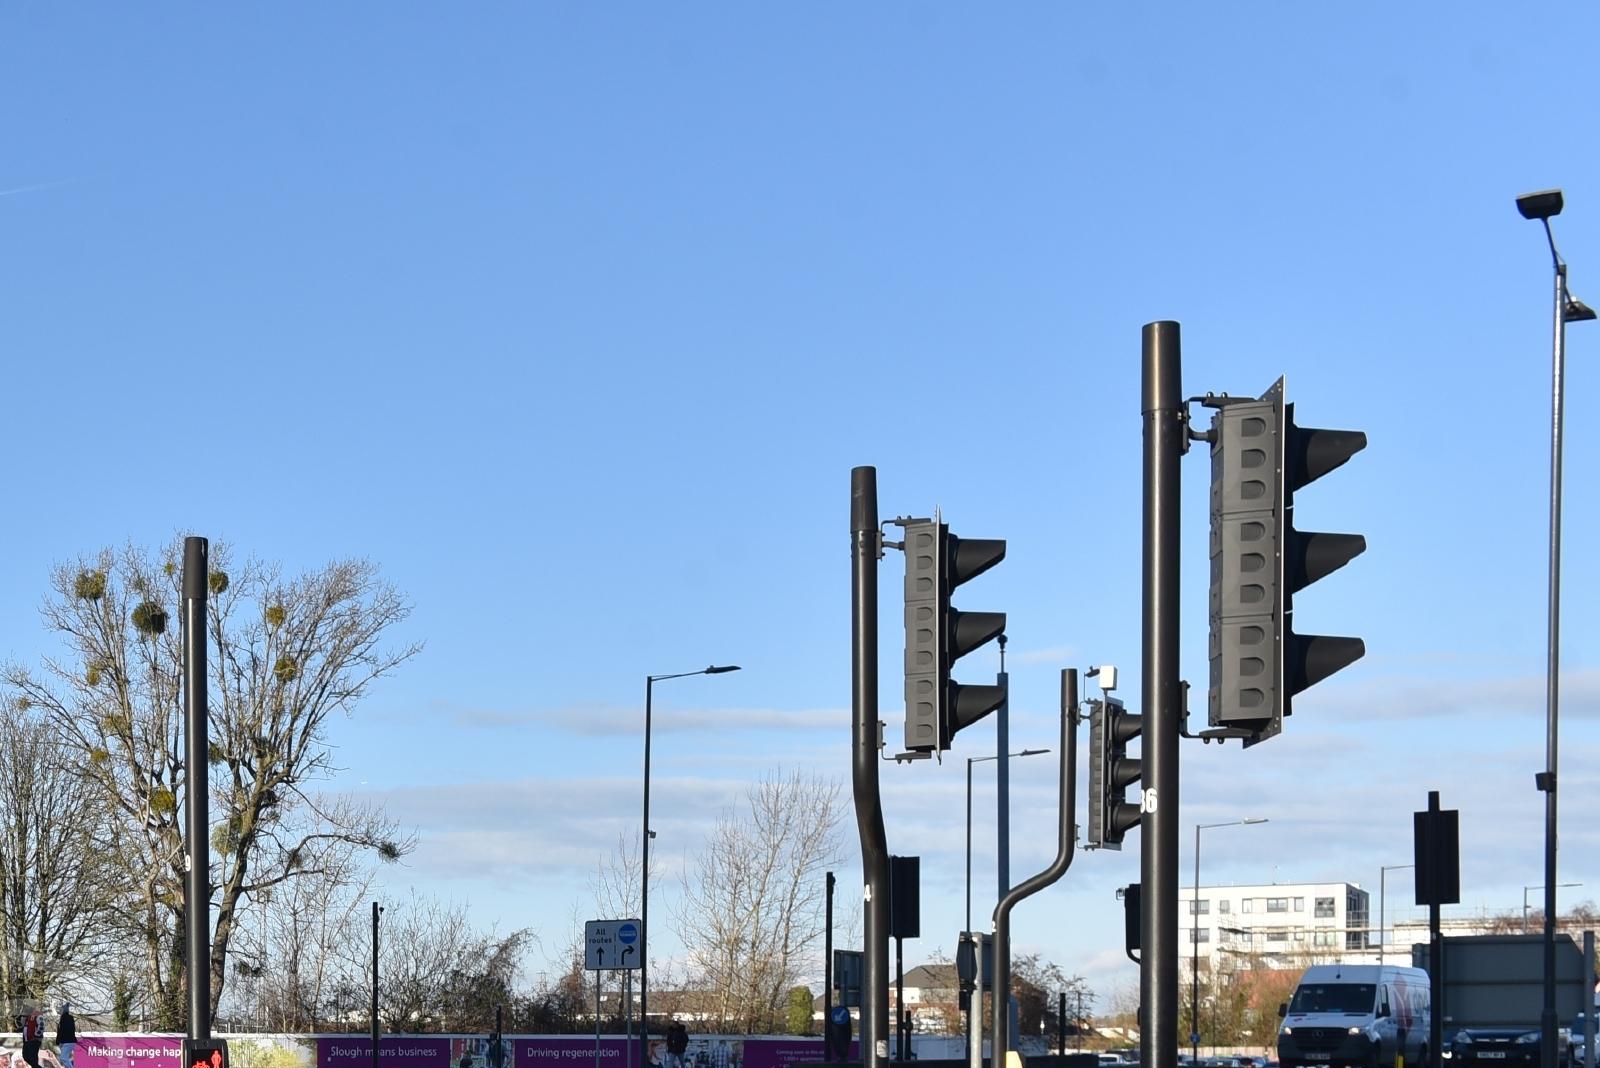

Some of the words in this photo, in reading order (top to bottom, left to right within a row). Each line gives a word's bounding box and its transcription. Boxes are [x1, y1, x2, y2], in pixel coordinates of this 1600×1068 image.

[595, 928, 606, 936] All
[88, 1045, 124, 1059] Making
[125, 1046, 161, 1059] change
[330, 1046, 363, 1058] Slough
[365, 1049, 396, 1057] mans
[398, 1046, 437, 1057] business
[527, 1047, 560, 1059] Driving
